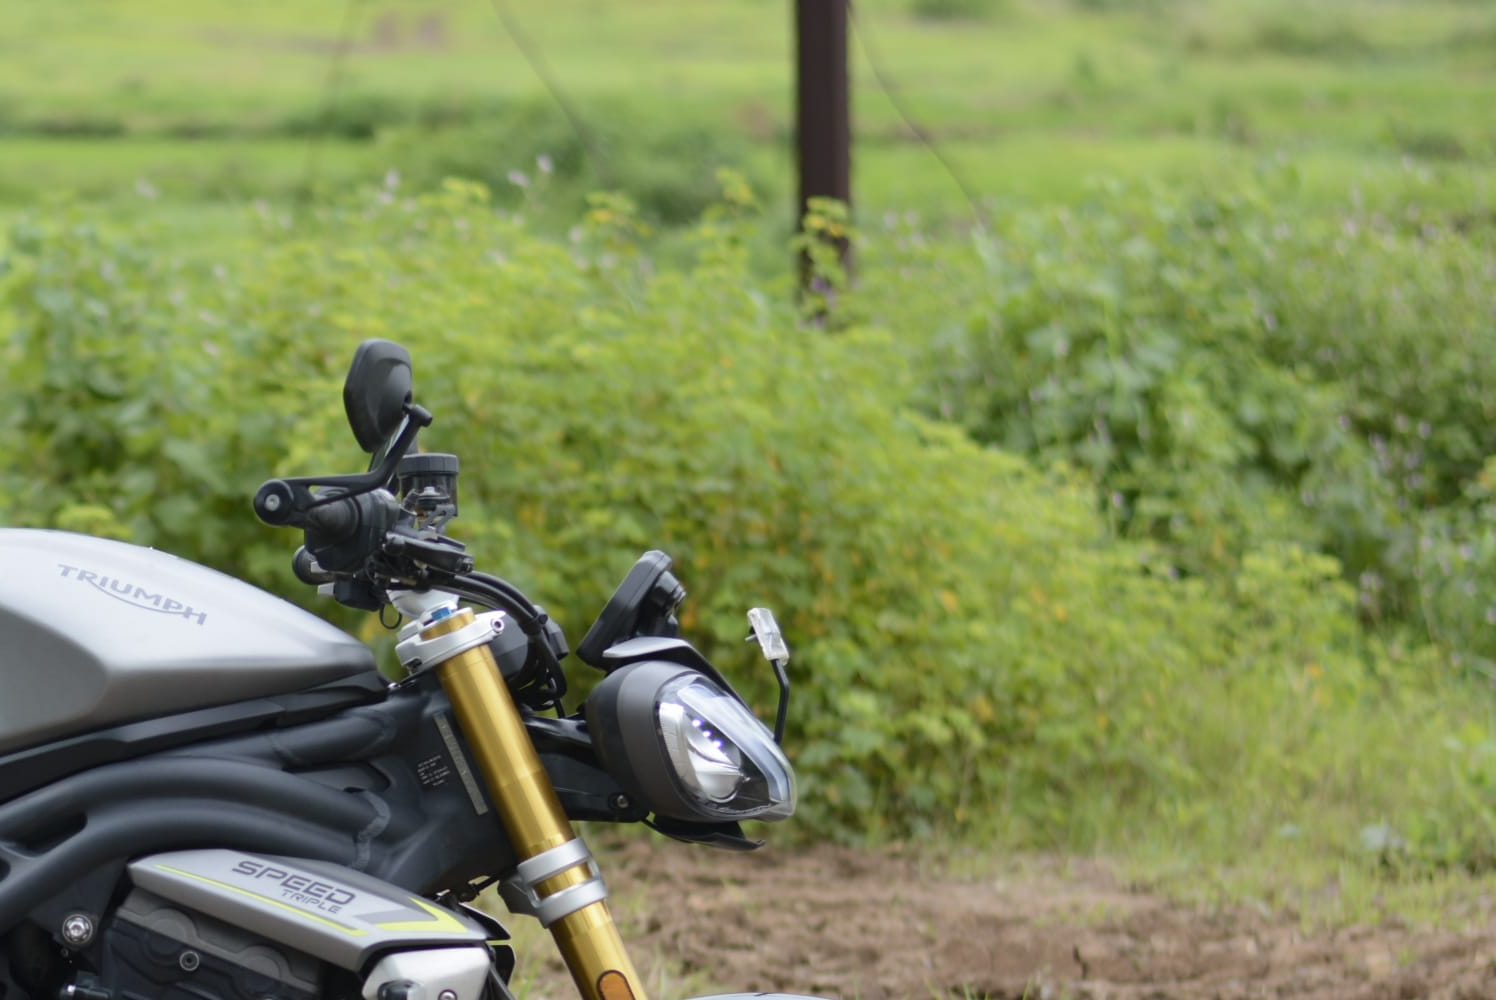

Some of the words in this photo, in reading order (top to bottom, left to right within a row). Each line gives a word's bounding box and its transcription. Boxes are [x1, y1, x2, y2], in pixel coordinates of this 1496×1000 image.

[58, 564, 207, 626] TRIUMPH
[232, 860, 356, 905] SPEED
[282, 888, 342, 914] TRIPLE
